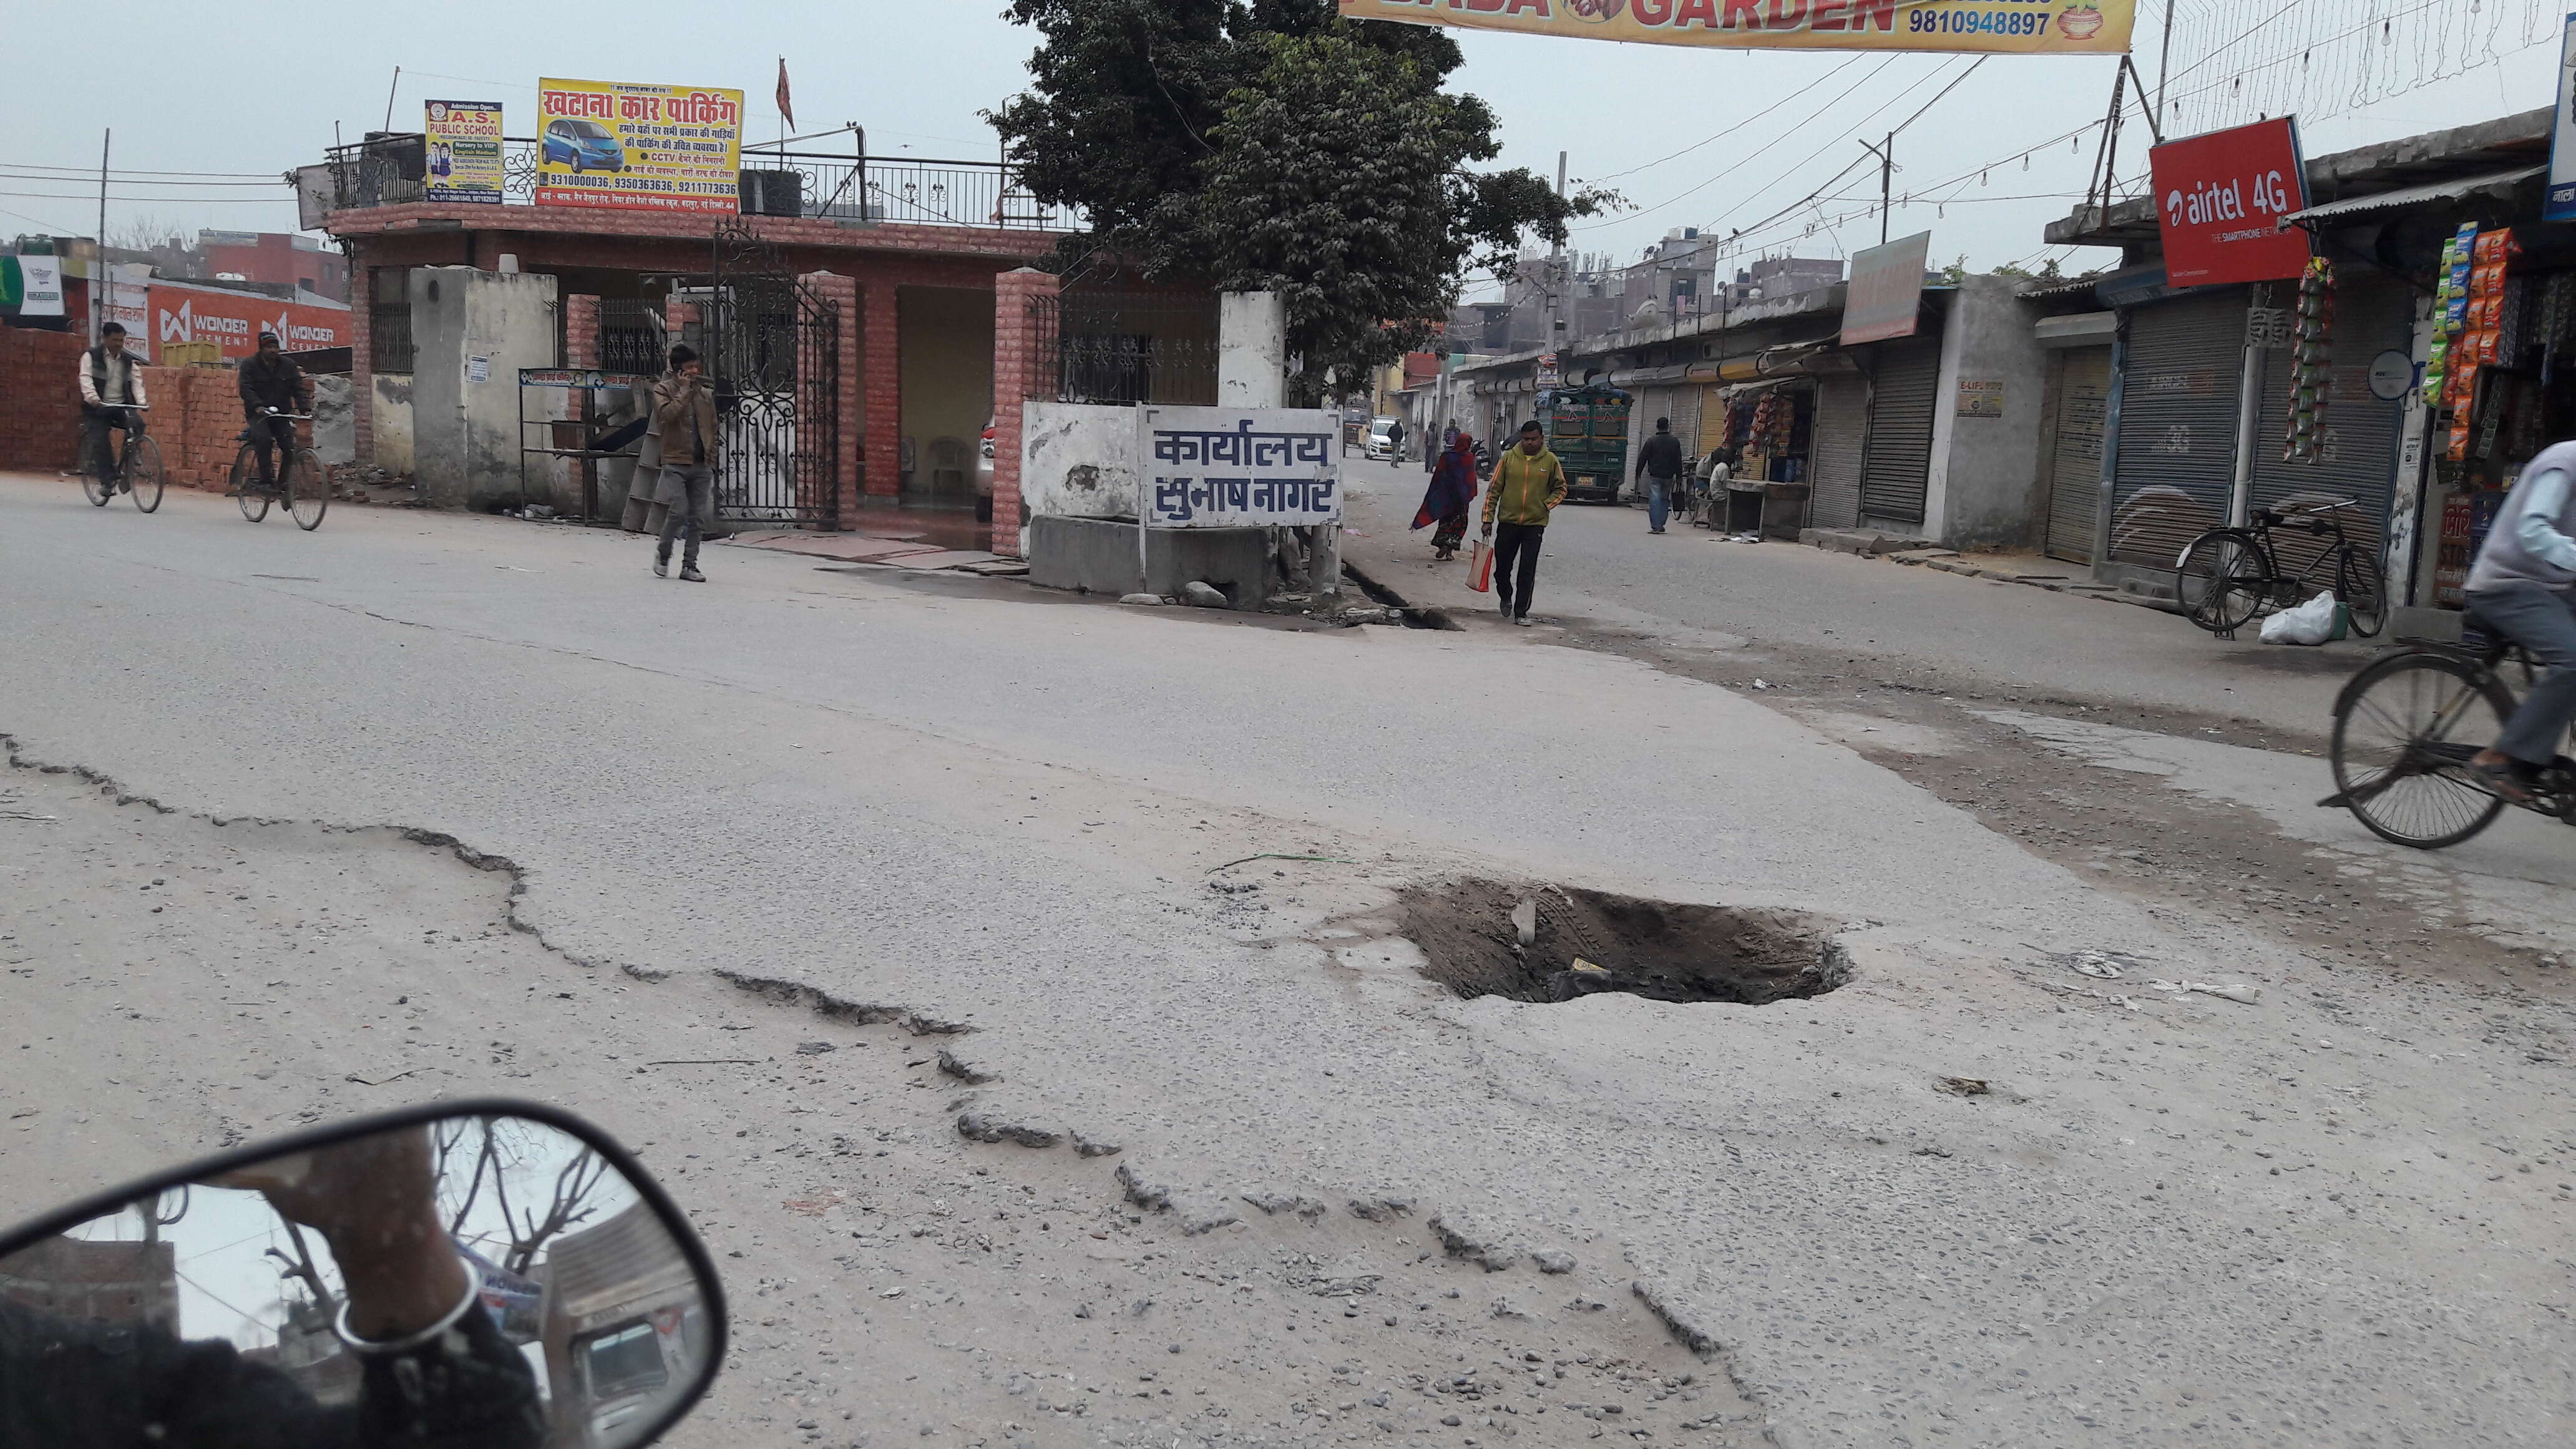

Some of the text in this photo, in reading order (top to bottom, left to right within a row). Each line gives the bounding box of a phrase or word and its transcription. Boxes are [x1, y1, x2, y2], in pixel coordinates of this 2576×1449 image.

[1631, 0, 1895, 31] GARDEN
[1910, 10, 2050, 36] 9810948897
[451, 111, 495, 124] A.S.
[544, 91, 736, 125] खटाना कार पार्किंग
[429, 124, 499, 135] PUBLIC SCHOOL
[619, 123, 635, 134] हमारे
[653, 127, 661, 135] पर
[663, 126, 677, 136] सभी
[680, 128, 698, 137] प्रकार
[700, 127, 709, 137] की
[625, 137, 634, 147] की
[637, 138, 660, 148] पार्किंग
[662, 139, 671, 149] की
[673, 140, 690, 150] उचित
[693, 142, 717, 152] व्यवस्था
[651, 154, 675, 162] CCTV
[552, 175, 736, 194] 9310000036, 9350363636, 9211773636
[2187, 170, 2287, 225] airtel 4G
[2222, 228, 2261, 242] SMARTPHONE
[193, 315, 248, 334] WONDER
[289, 324, 334, 343] WONDER
[1153, 419, 1333, 466] कार्यालय
[1155, 477, 1335, 520] सुभाष नगर
